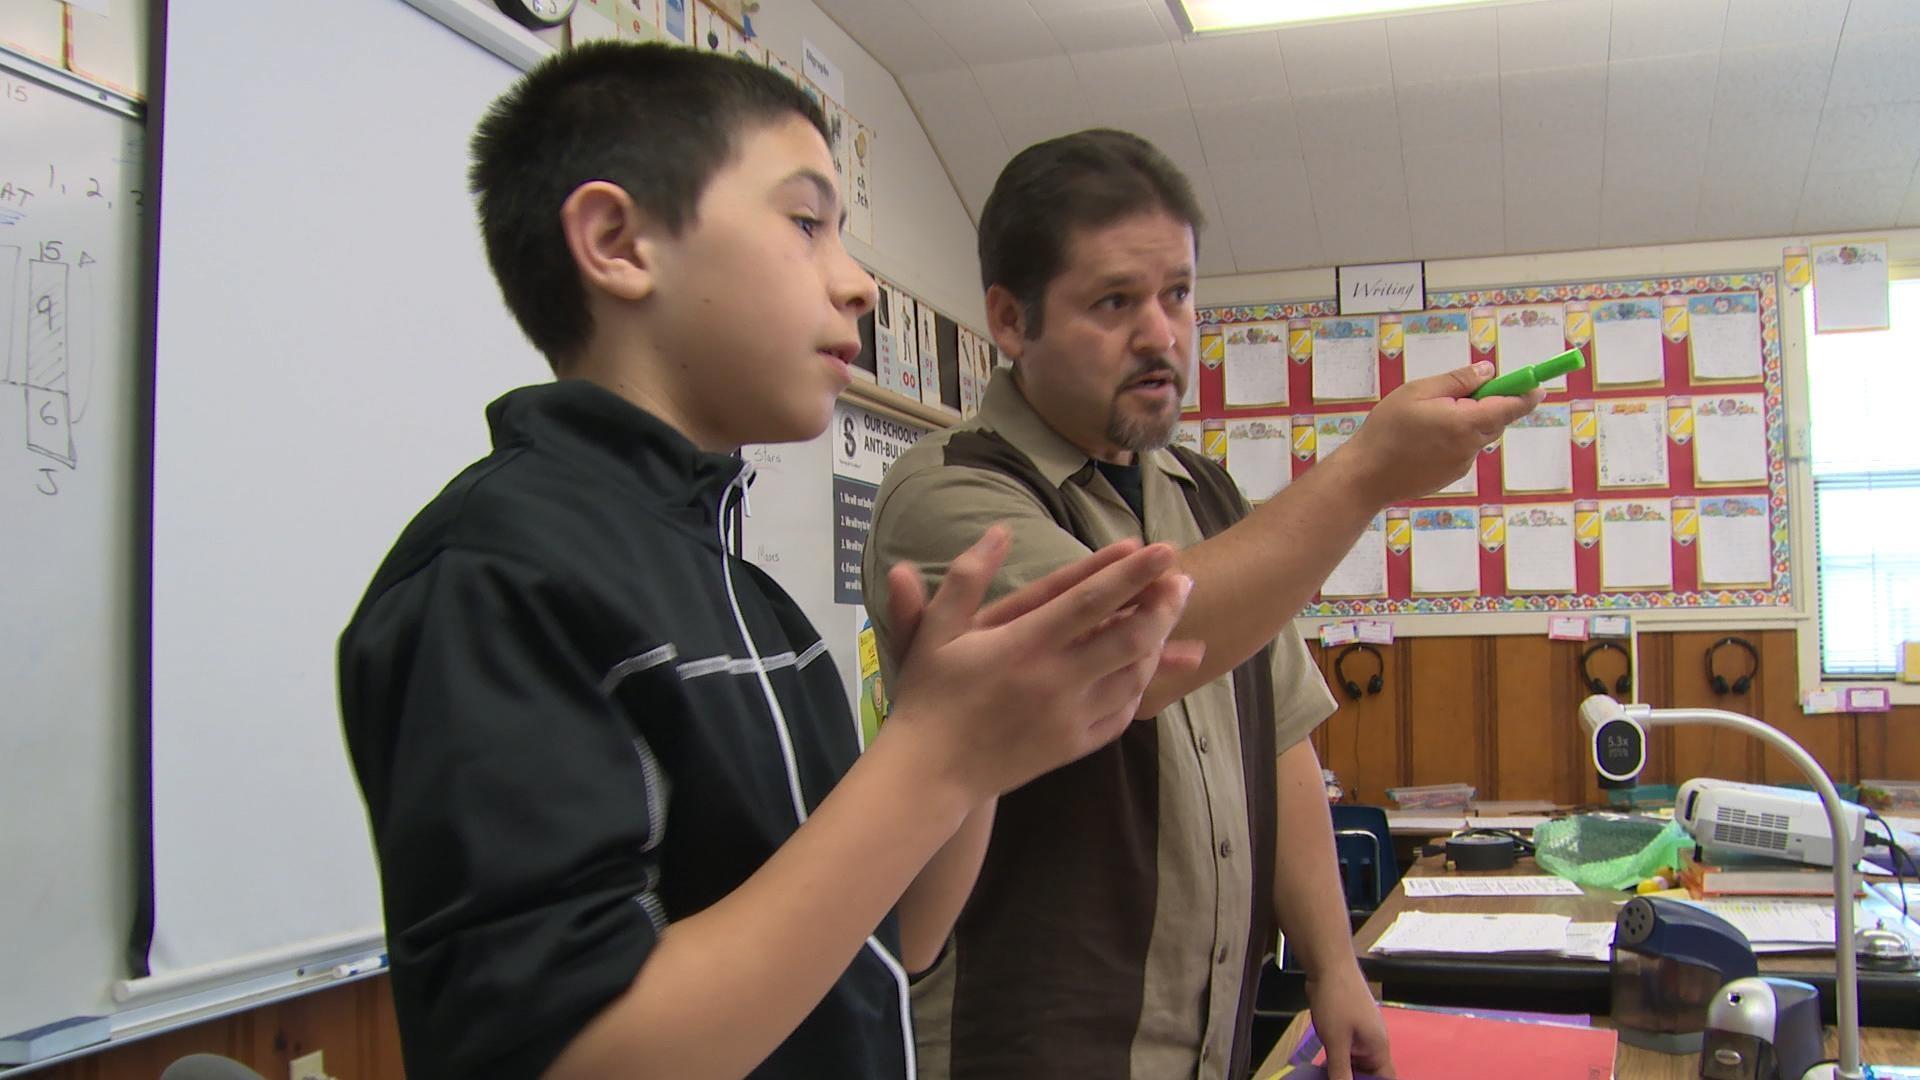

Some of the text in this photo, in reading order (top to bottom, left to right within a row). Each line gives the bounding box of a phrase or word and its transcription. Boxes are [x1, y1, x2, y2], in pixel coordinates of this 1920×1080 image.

[6, 81, 28, 103] 15
[39, 240, 63, 262] 15
[1352, 278, 1415, 305] Writing
[36, 295, 53, 331] 9
[39, 400, 59, 426] 6
[864, 413, 919, 445] OUR SCHOOL'S
[36, 467, 59, 496] J
